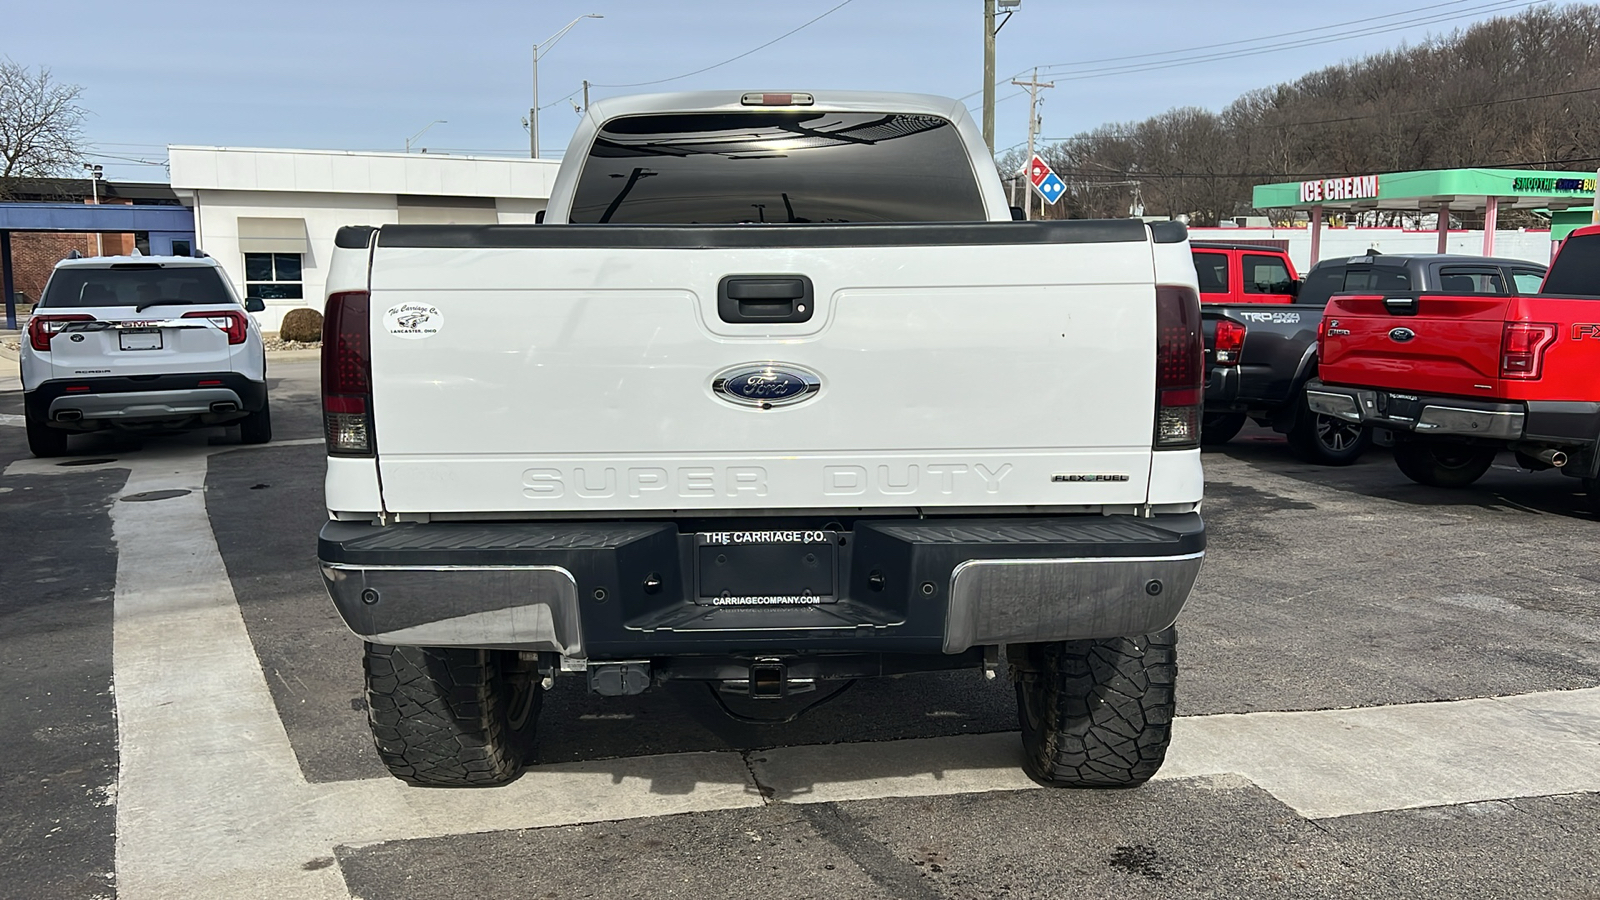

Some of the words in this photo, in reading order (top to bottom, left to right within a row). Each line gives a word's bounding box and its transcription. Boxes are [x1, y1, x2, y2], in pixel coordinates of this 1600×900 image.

[1300, 180, 1323, 202] ICE
[1325, 175, 1378, 200] CREAM
[1513, 177, 1557, 189] SMOOTHIE
[388, 307, 399, 316] The
[400, 304, 428, 313] Carriage
[1240, 312, 1273, 323] TRD
[742, 375, 788, 396] Ford
[521, 466, 768, 499] SUPER
[823, 462, 1013, 496] DUTY
[703, 532, 732, 543] THE
[733, 531, 802, 543] CARRIAGE
[804, 531, 827, 543] CO.
[712, 596, 821, 606] CARRIAGECOMPANY.COM
